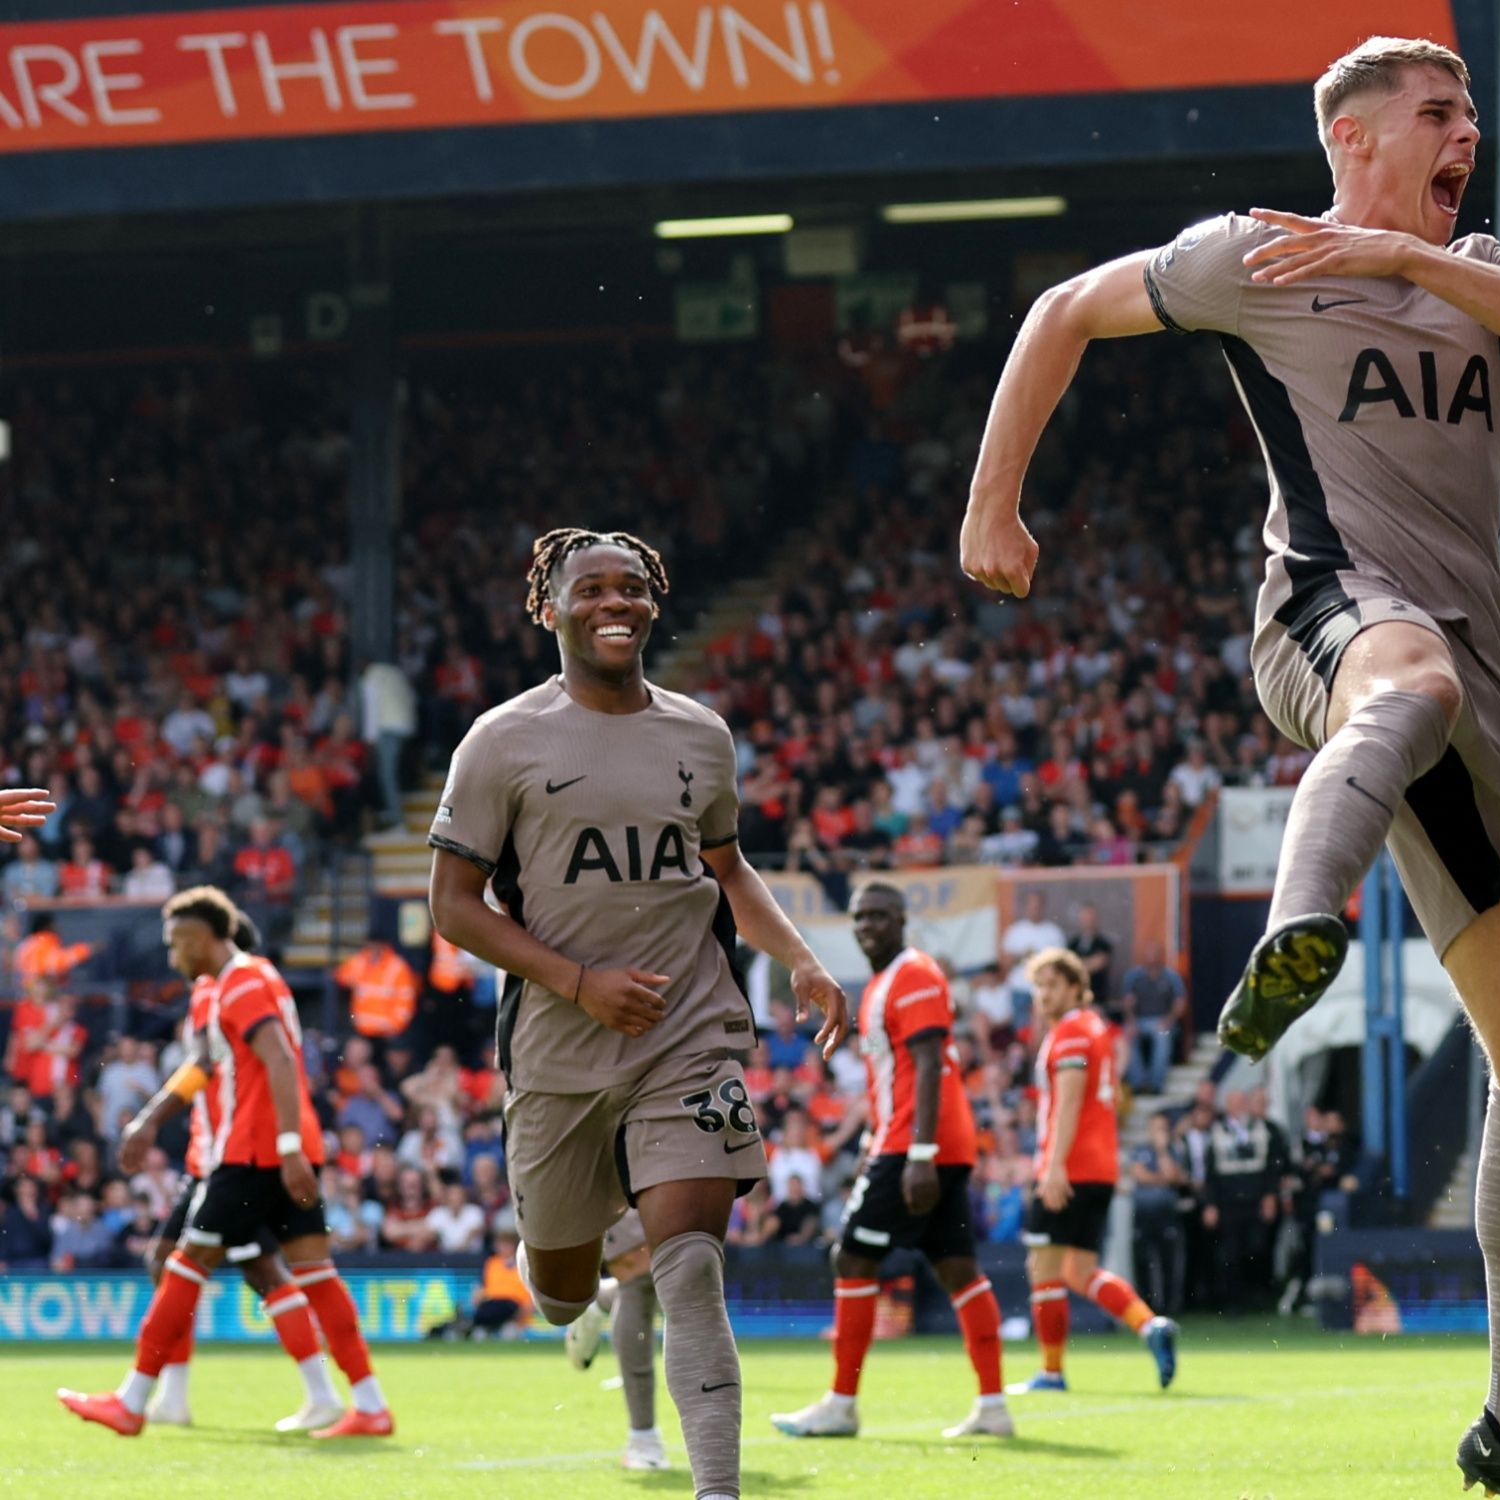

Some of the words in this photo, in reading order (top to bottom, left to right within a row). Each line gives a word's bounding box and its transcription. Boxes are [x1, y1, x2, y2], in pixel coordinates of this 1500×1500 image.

[176, 22, 417, 119] THE
[434, 0, 841, 103] TOWN!
[1338, 347, 1494, 433] AIA
[563, 824, 694, 885] AIA
[680, 1077, 758, 1134] 38
